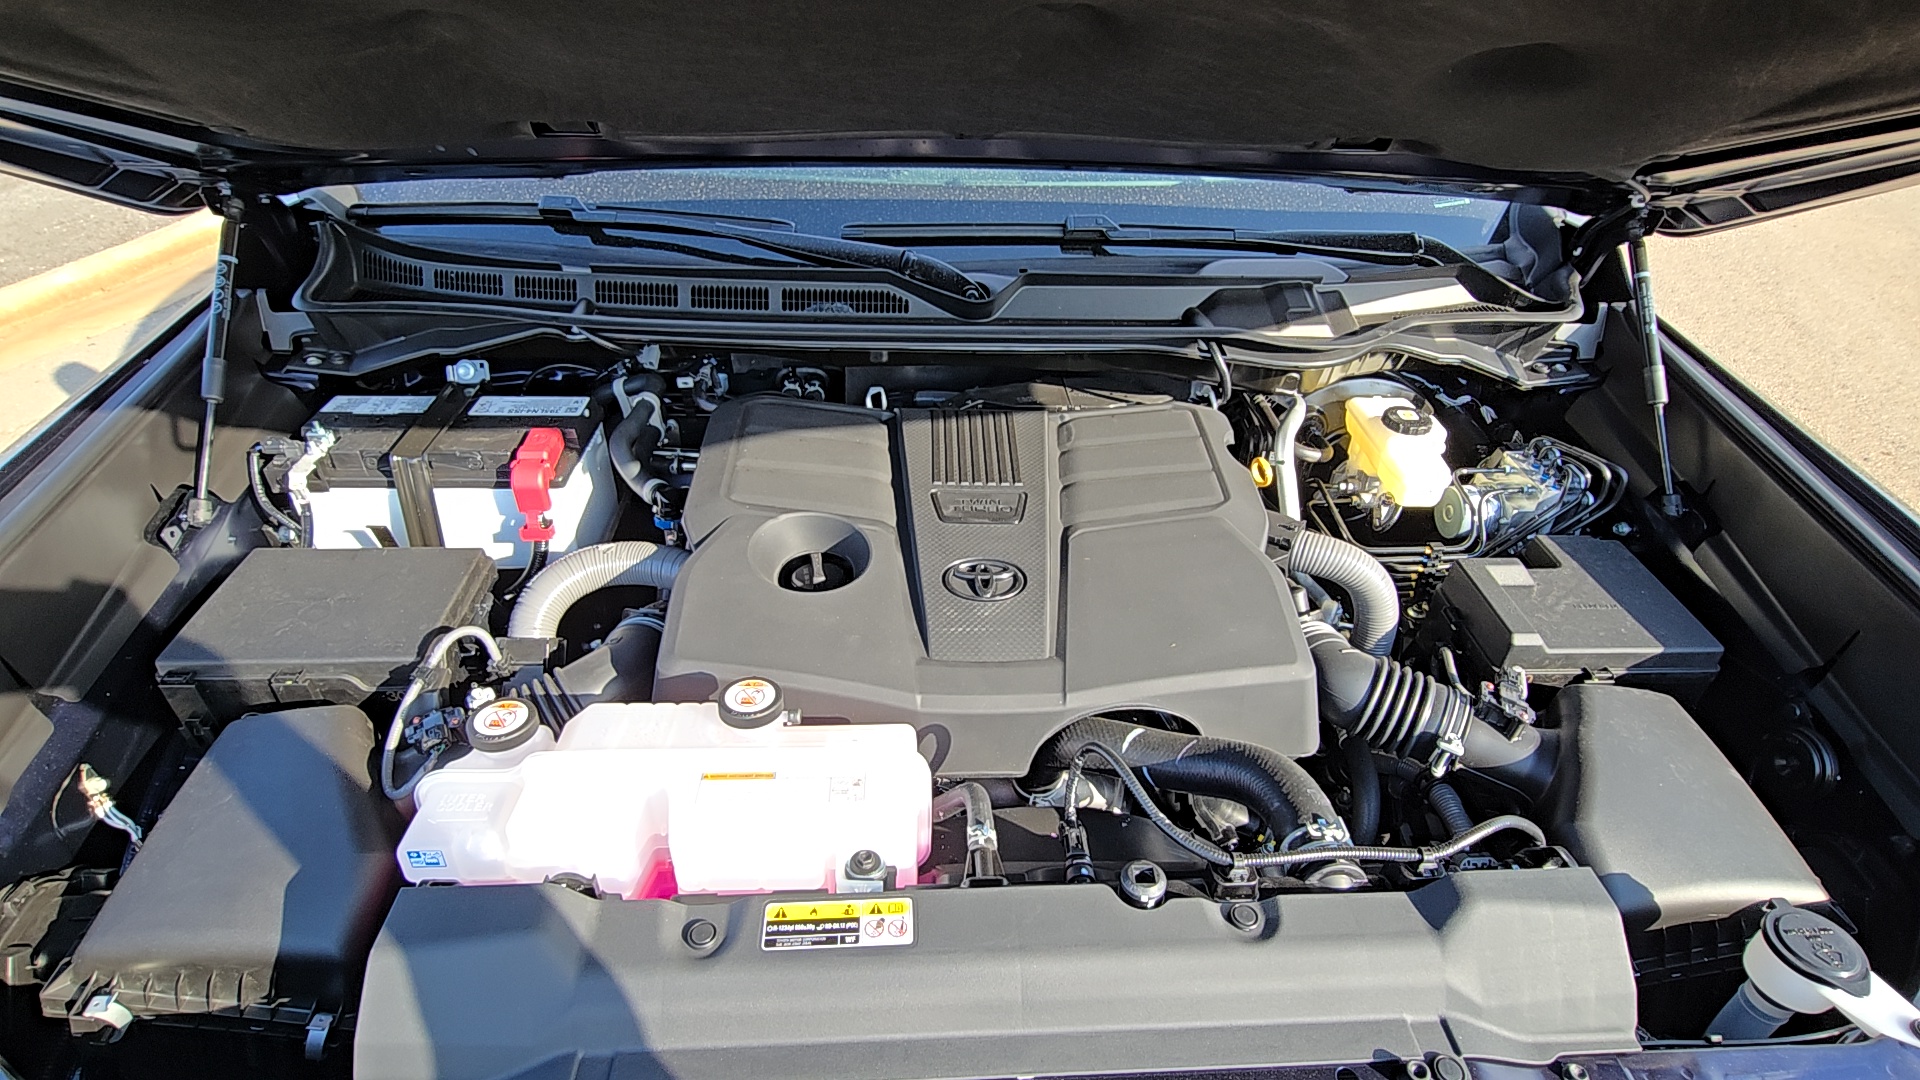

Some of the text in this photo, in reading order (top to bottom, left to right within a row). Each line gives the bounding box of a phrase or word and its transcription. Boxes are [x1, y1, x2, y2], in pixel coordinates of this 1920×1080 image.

[951, 505, 1013, 513] TURBO
[441, 793, 487, 803] INTER
[436, 802, 494, 812] COOLER
